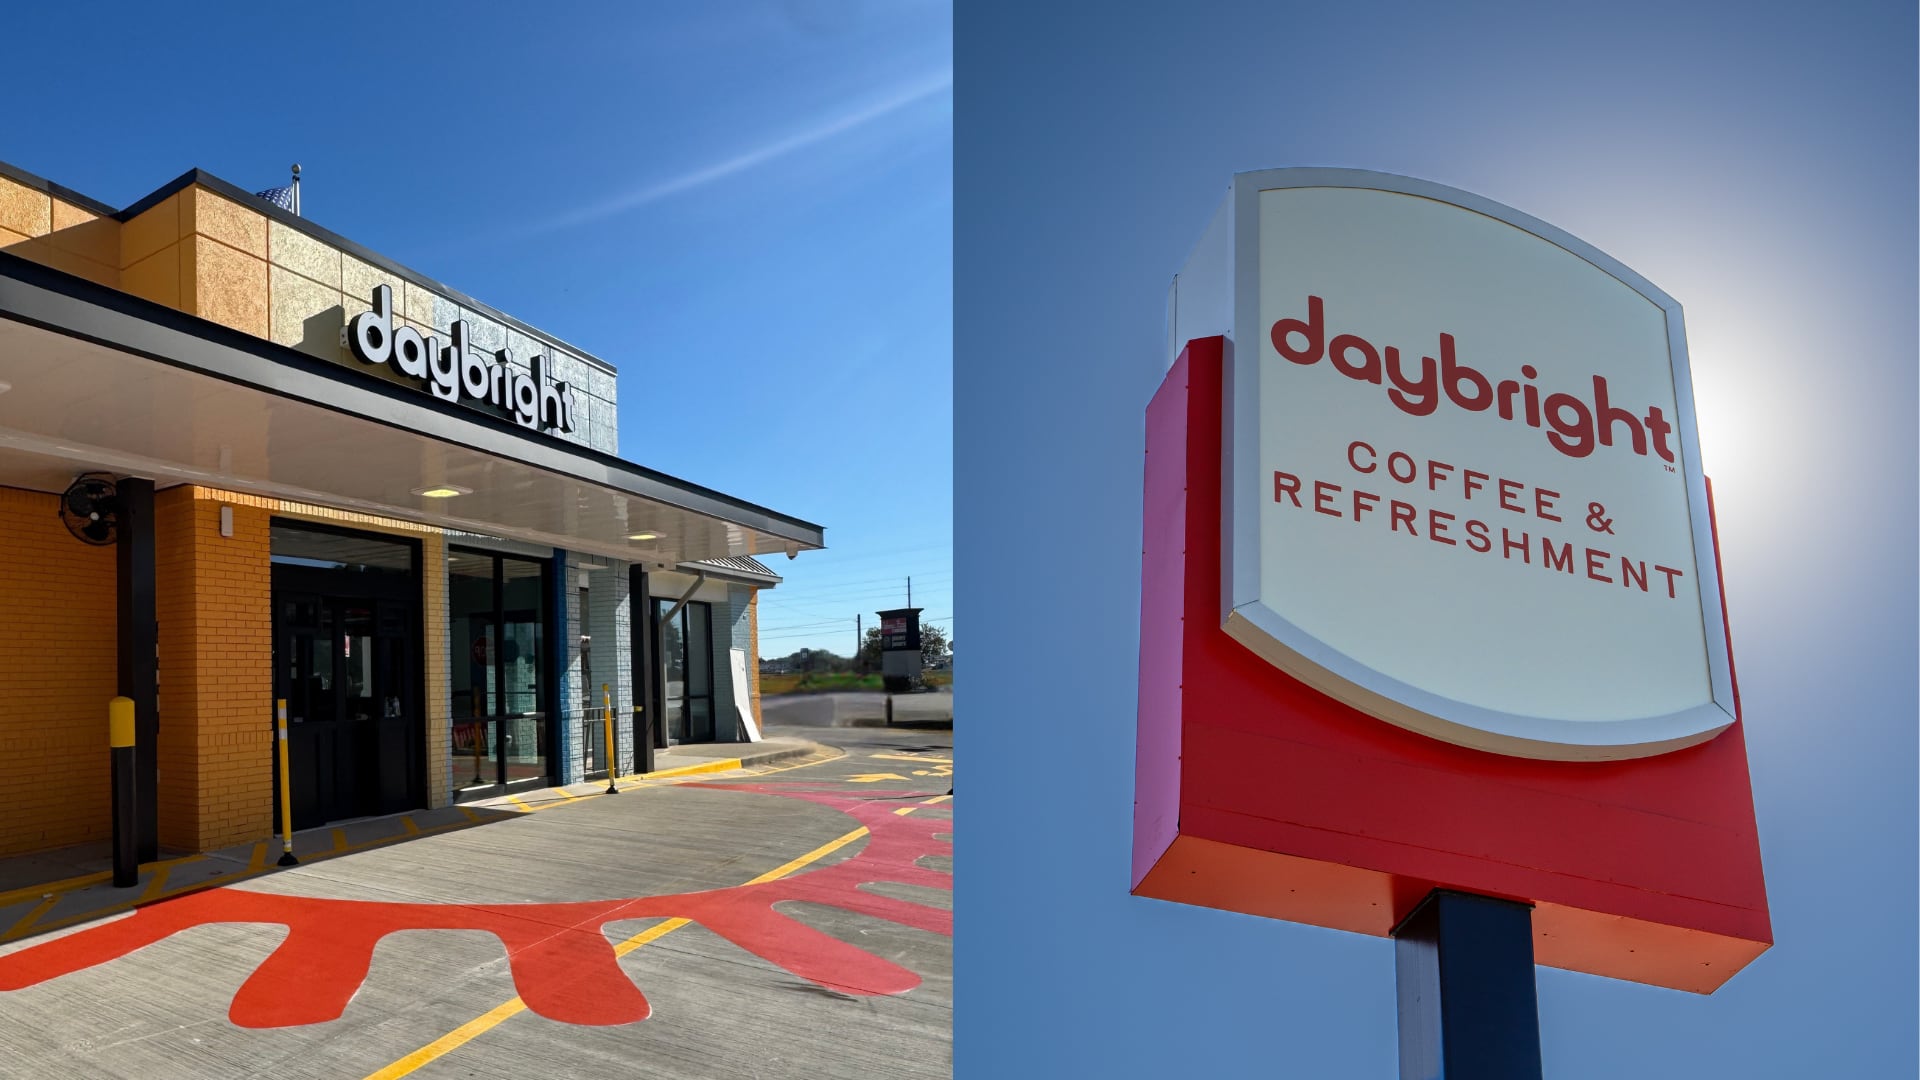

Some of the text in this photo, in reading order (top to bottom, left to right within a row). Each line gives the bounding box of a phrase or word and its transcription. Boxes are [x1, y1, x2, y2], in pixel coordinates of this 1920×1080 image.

[350, 284, 576, 434] daybright
[1270, 295, 1675, 464] daybright
[1274, 470, 1684, 599] REFRESHMENT
[1347, 441, 1615, 535] COFFEE &
